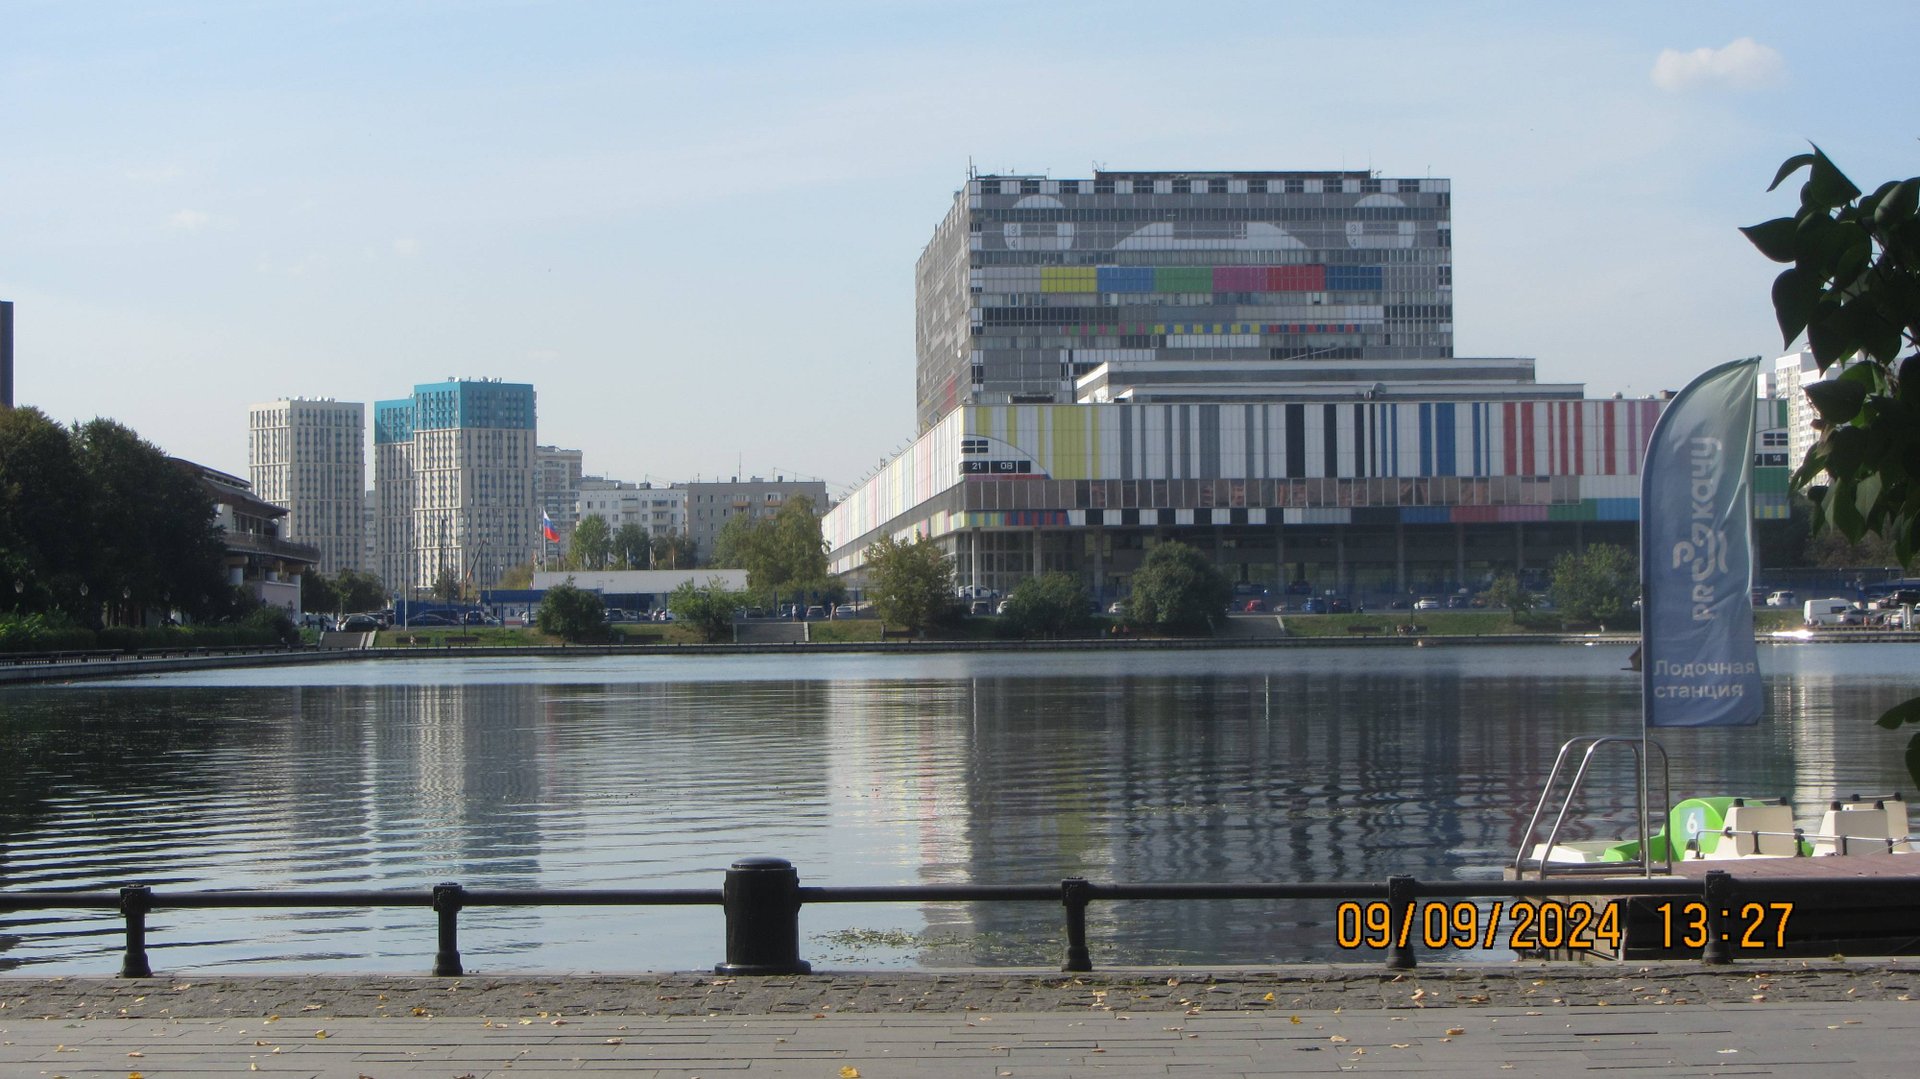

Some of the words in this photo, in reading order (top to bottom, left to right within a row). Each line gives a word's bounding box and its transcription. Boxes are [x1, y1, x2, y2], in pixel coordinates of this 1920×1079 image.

[971, 462, 981, 470] 21
[1000, 462, 1013, 470] 08
[1653, 660, 1755, 678] Лодочная
[1653, 683, 1744, 699] станция
[1686, 812, 1697, 833] 6
